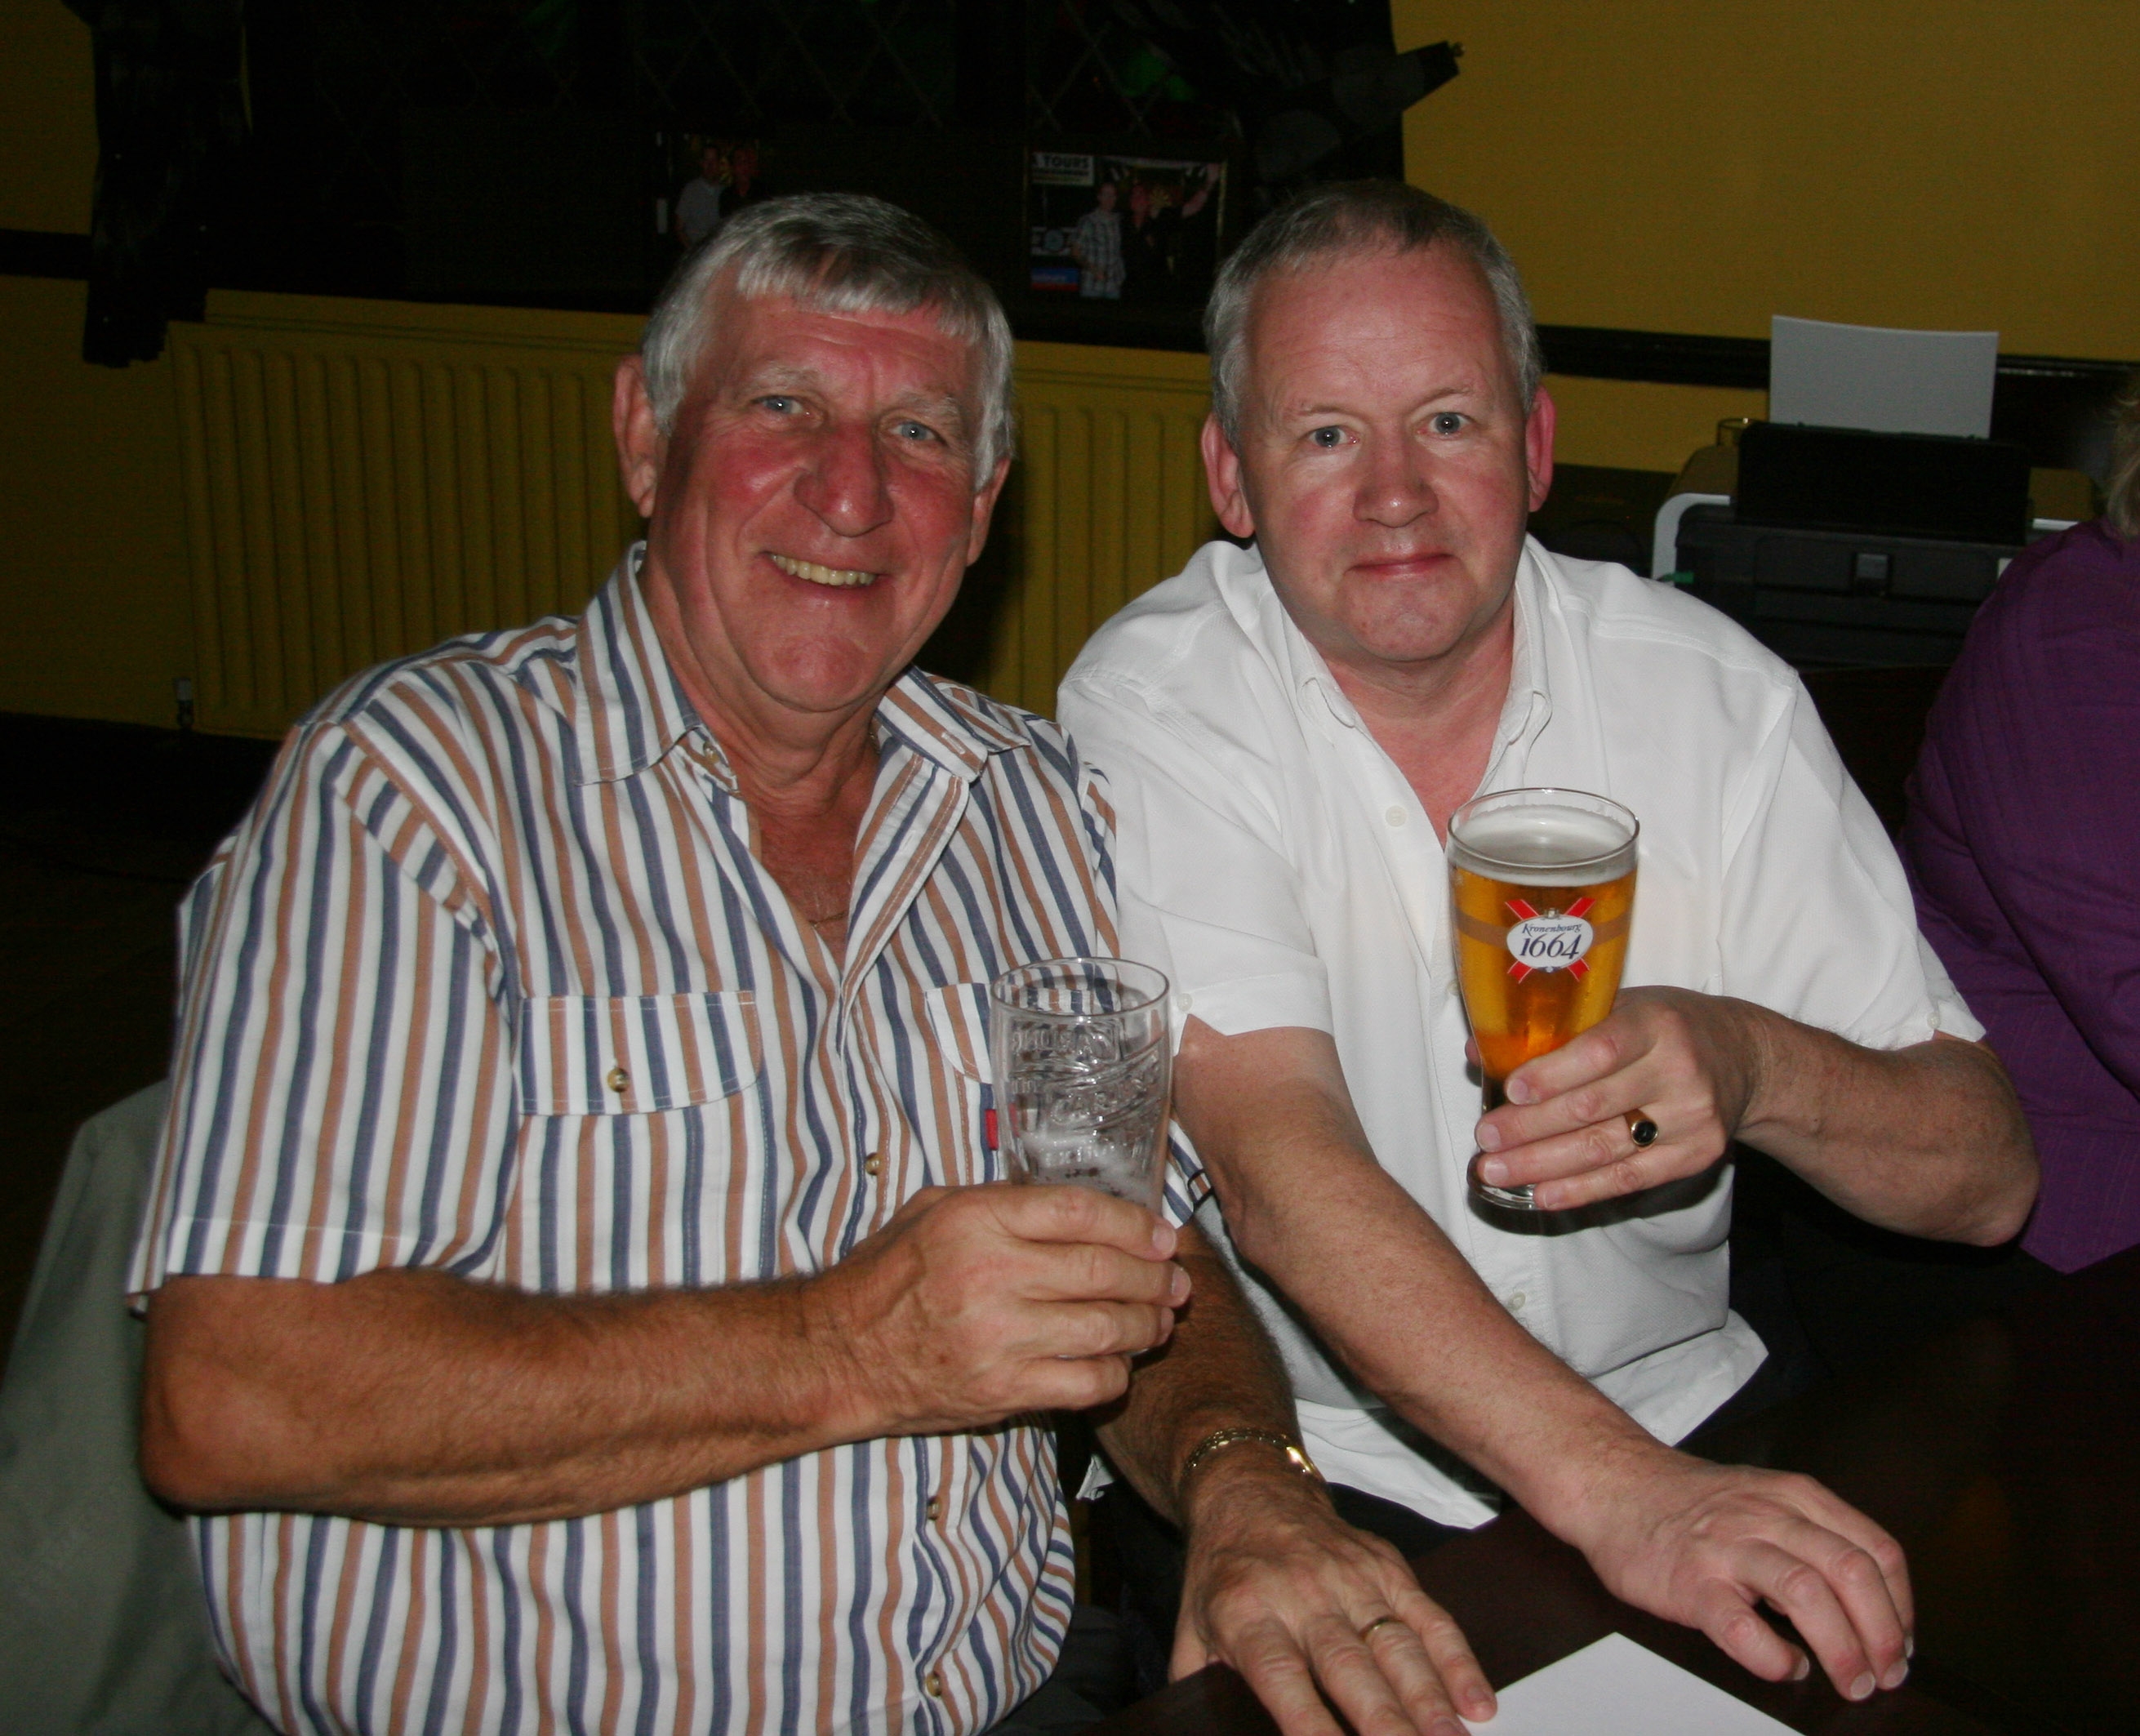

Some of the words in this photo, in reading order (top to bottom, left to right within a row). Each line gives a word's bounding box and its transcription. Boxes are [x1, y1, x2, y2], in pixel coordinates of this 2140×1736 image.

[1044, 155, 1088, 169] TOURS
[1522, 923, 1582, 937] Kronenbourg
[1519, 933, 1582, 959] 1664
